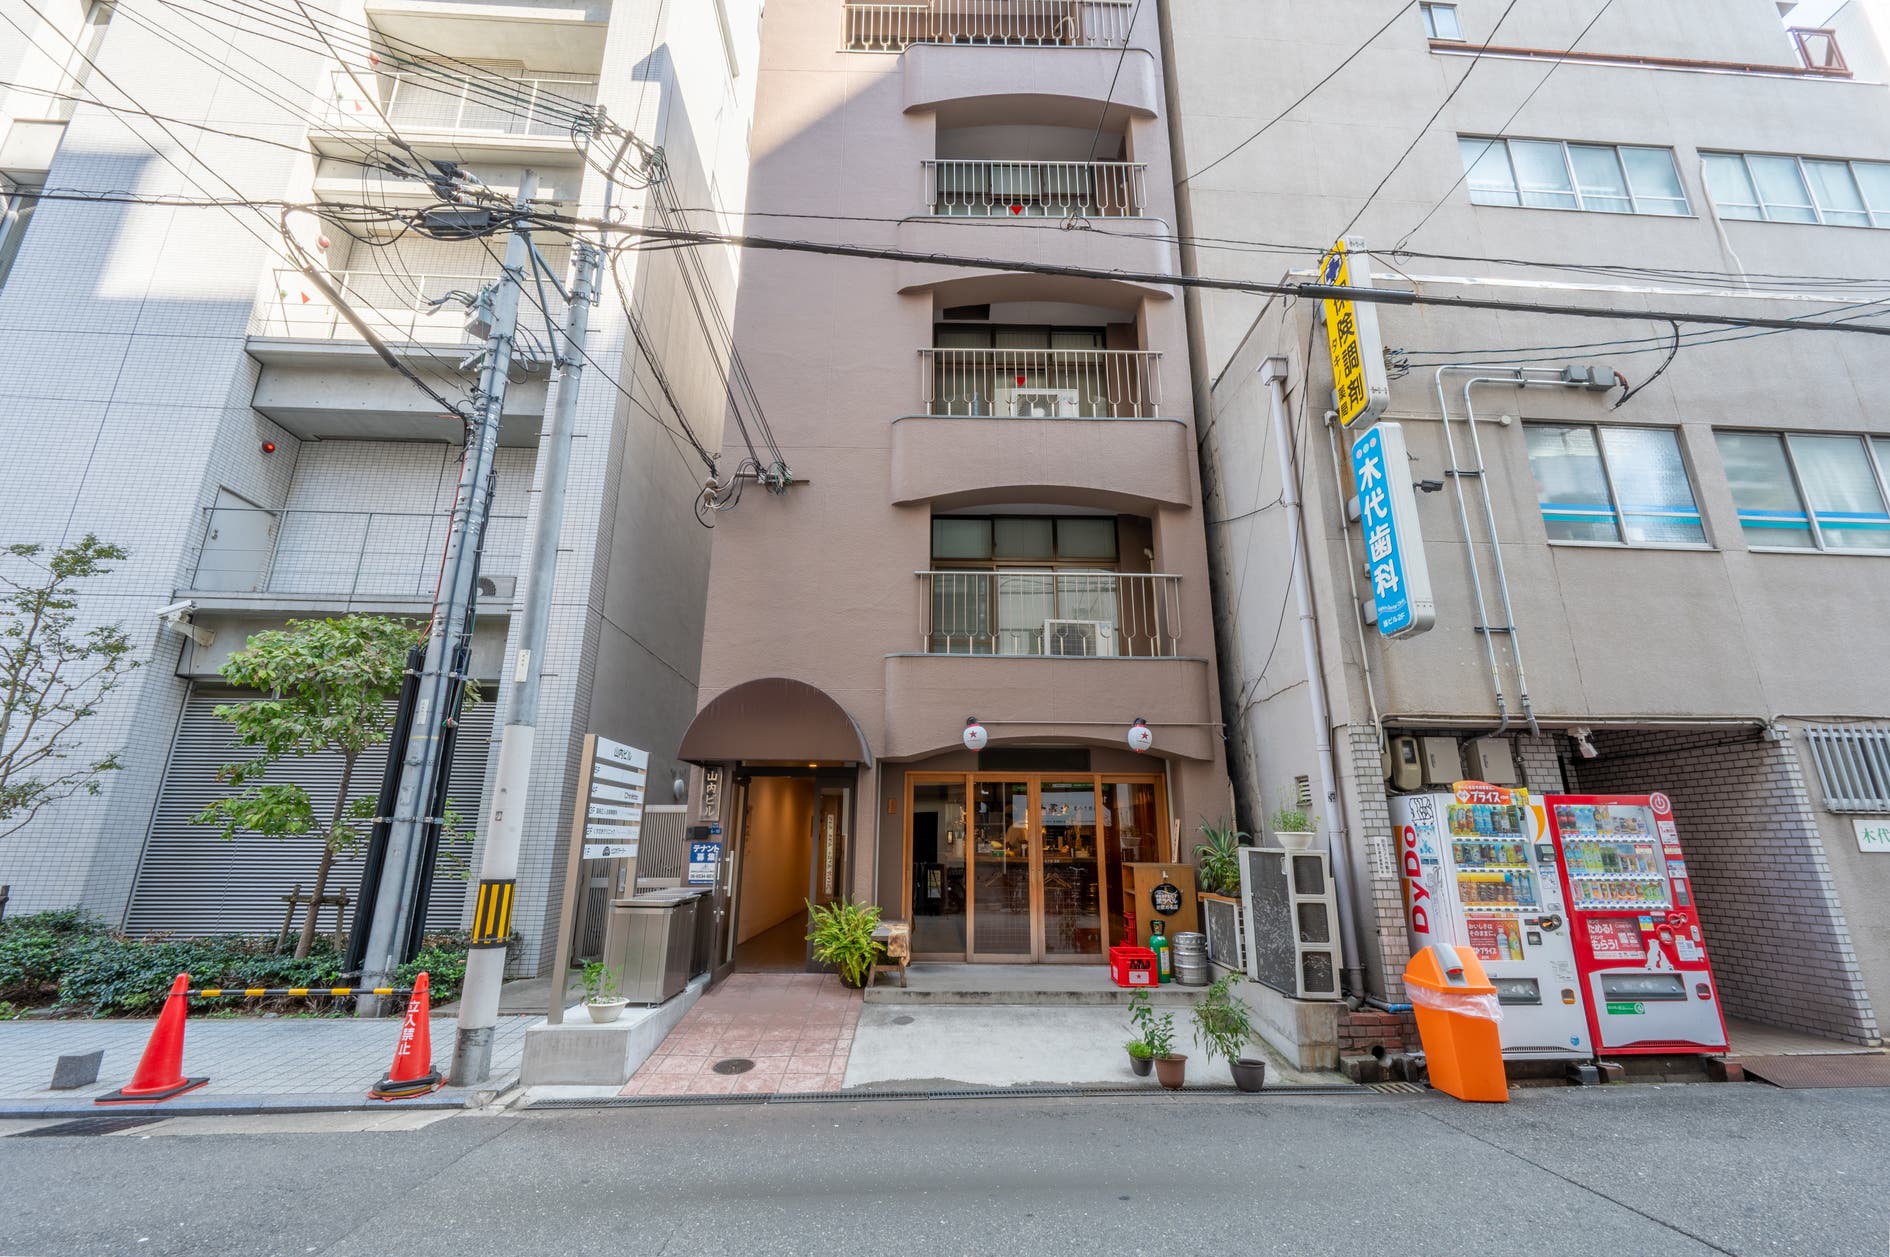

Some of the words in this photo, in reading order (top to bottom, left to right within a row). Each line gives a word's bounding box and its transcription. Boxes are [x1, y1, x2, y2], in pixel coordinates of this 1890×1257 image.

[1358, 456, 1400, 599] 木代歯科
[704, 770, 718, 817] 山内ビル
[1470, 791, 1502, 803] プライス
[693, 844, 720, 853] テナント
[398, 1000, 421, 1056] 立入禁止
